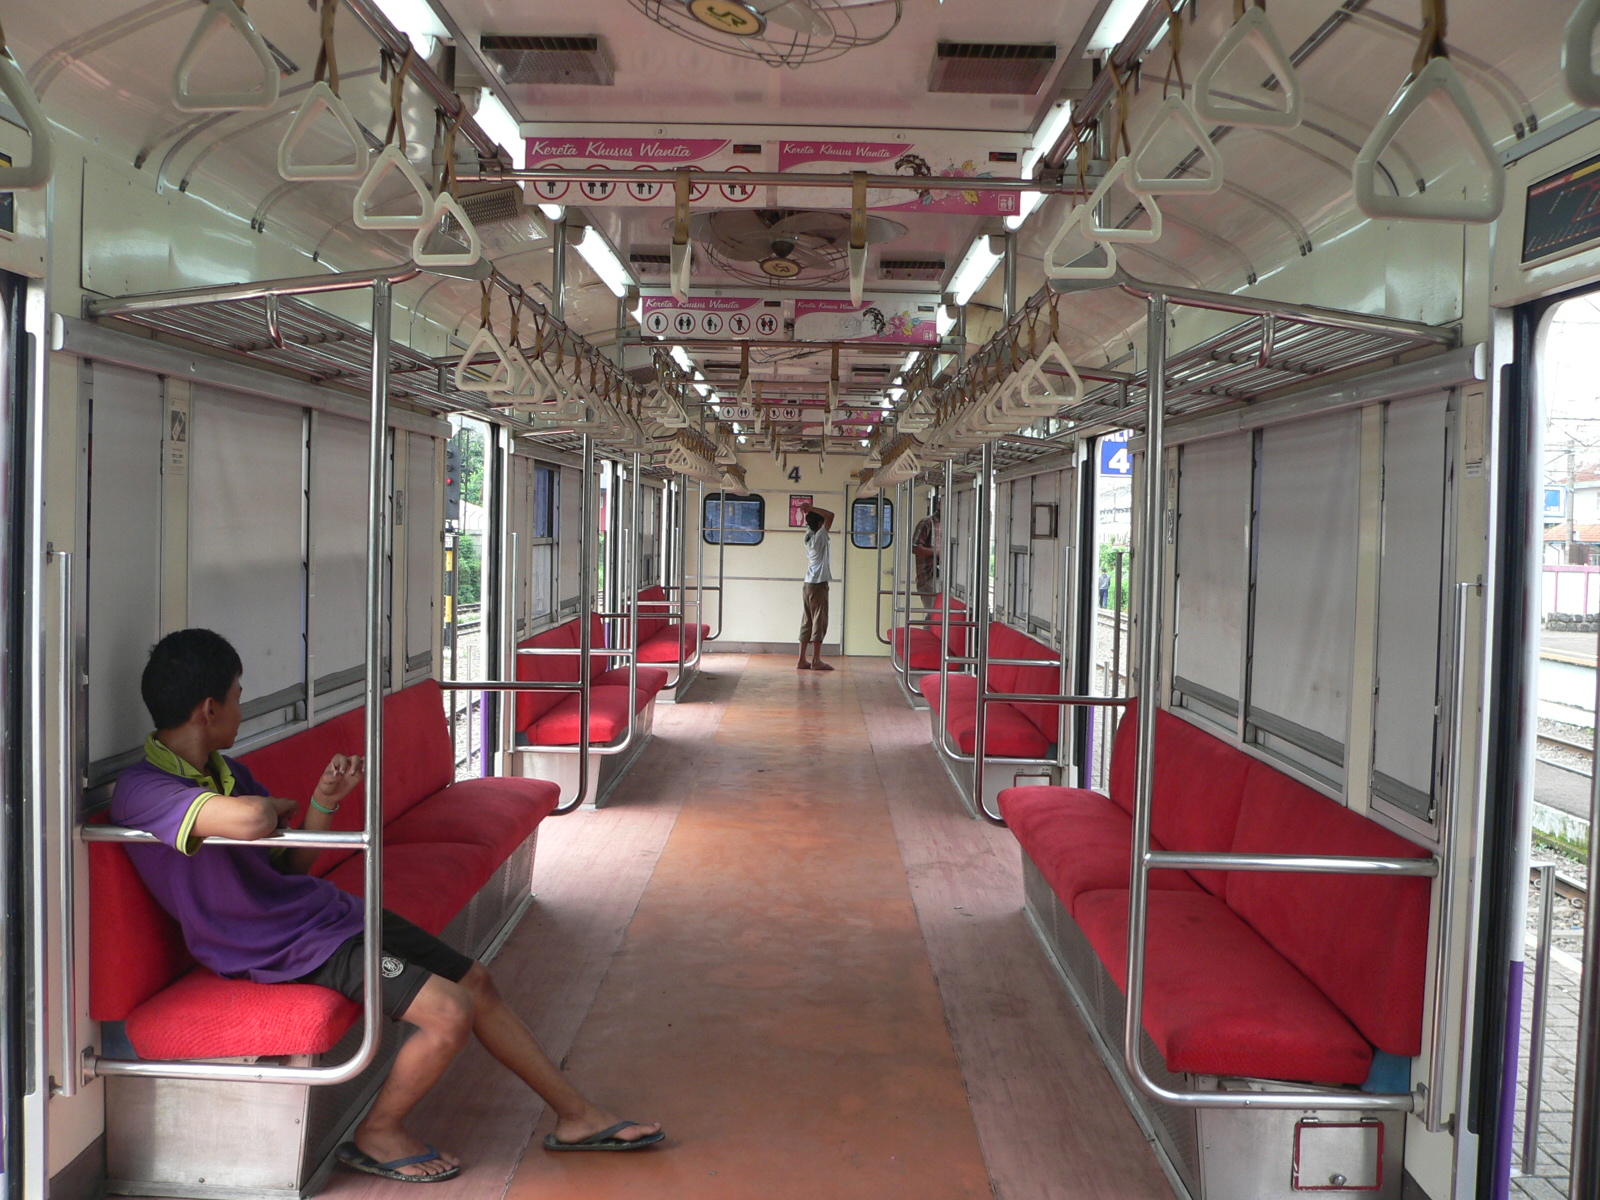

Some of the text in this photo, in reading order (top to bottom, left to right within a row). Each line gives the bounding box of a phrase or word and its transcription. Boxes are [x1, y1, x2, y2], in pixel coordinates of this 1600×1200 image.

[532, 141, 692, 158] Kereta Khusus Wanita
[783, 143, 892, 158] Kereta Khusus Wanita
[645, 298, 740, 309] Kereta Khusus Wanita
[1109, 448, 1130, 473] 4
[787, 466, 801, 484] 4
